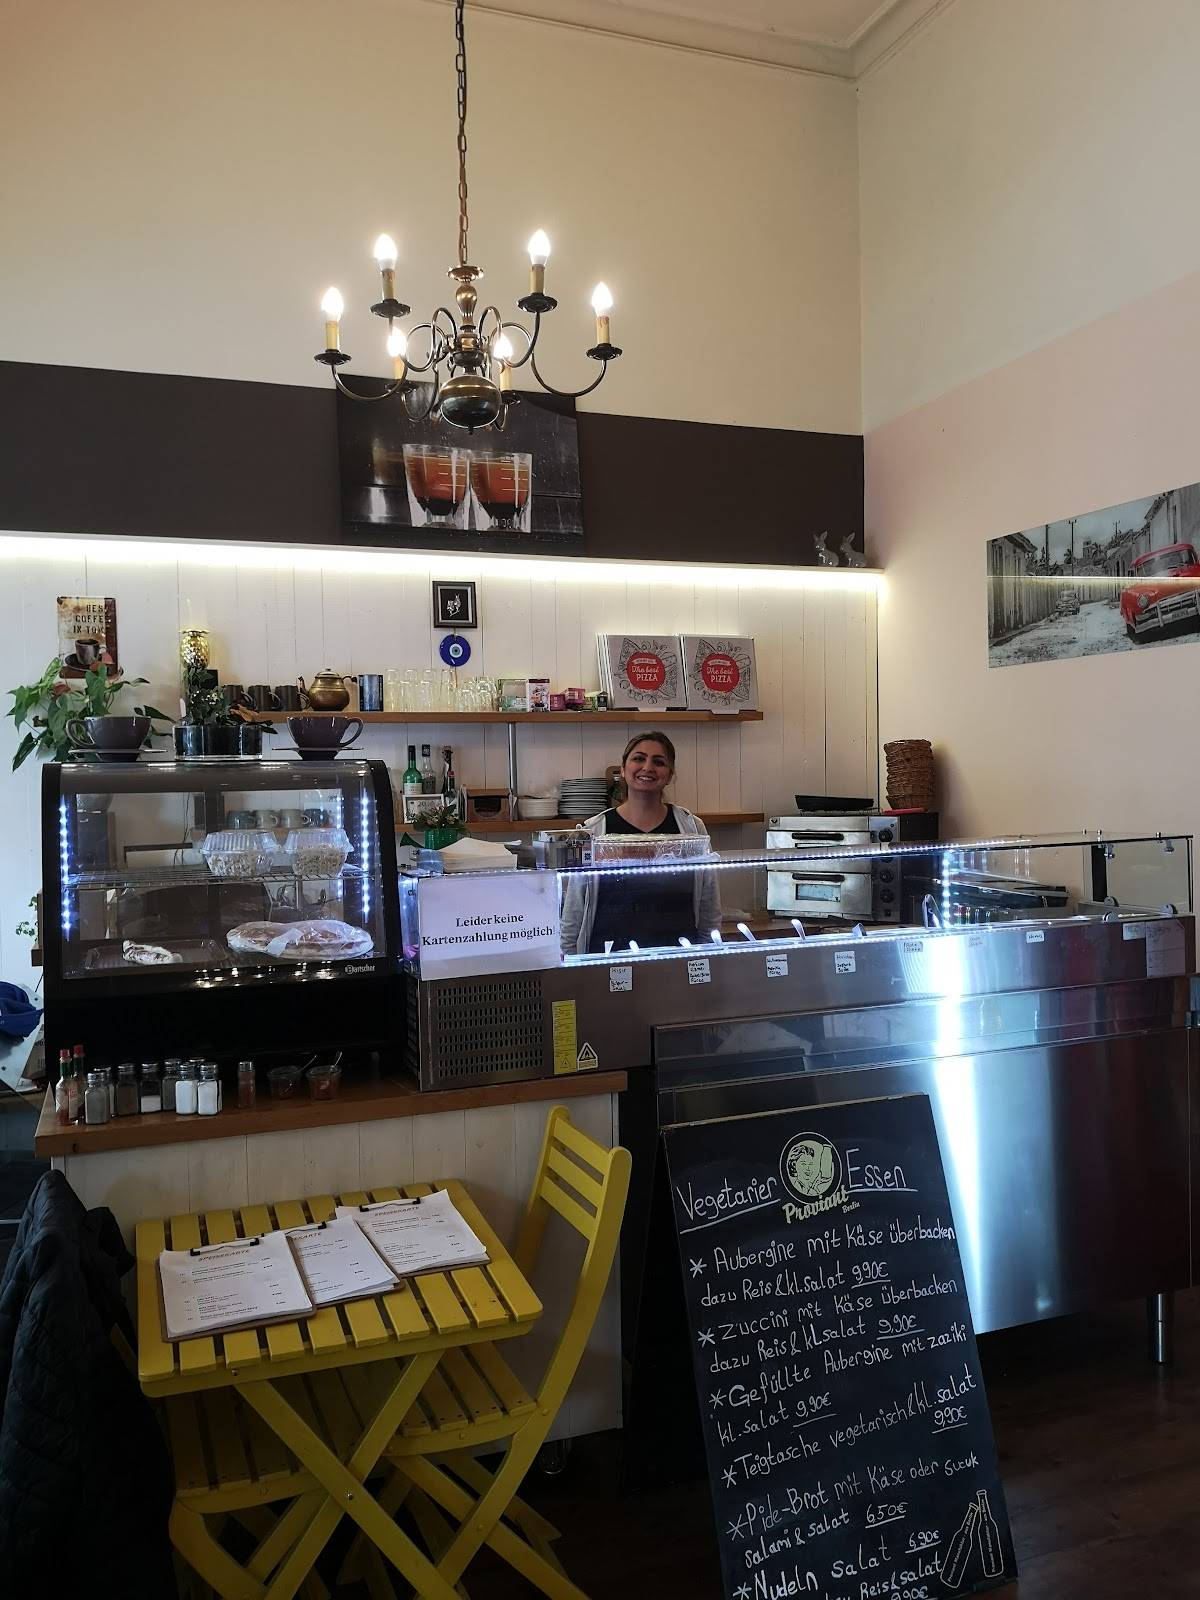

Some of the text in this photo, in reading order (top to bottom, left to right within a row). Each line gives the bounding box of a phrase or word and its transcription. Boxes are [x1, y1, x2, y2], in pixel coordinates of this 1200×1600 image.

[636, 673, 658, 682] PIZZA
[710, 675, 732, 683] PIZZA
[455, 914, 524, 928] Leider keine
[422, 930, 508, 946] Kartenzahlung
[676, 1147, 907, 1221] Vegetarier Essen
[782, 1184, 850, 1224] Proviant
[841, 1200, 861, 1214] Berlin
[713, 1214, 956, 1274] Aubergine mit Käse überbacken
[700, 1282, 737, 1307] dazu
[797, 1300, 823, 1323] mit
[833, 1292, 873, 1315] Käse
[710, 1350, 750, 1373] dazu
[728, 1364, 812, 1407] Gefüllte
[823, 1344, 893, 1374] Aubergine
[902, 1337, 925, 1357] mit
[733, 1433, 821, 1479] Teigtasche
[867, 1465, 906, 1494] Käse
[909, 1457, 939, 1479] oder
[754, 1564, 819, 1600] Nudeln
